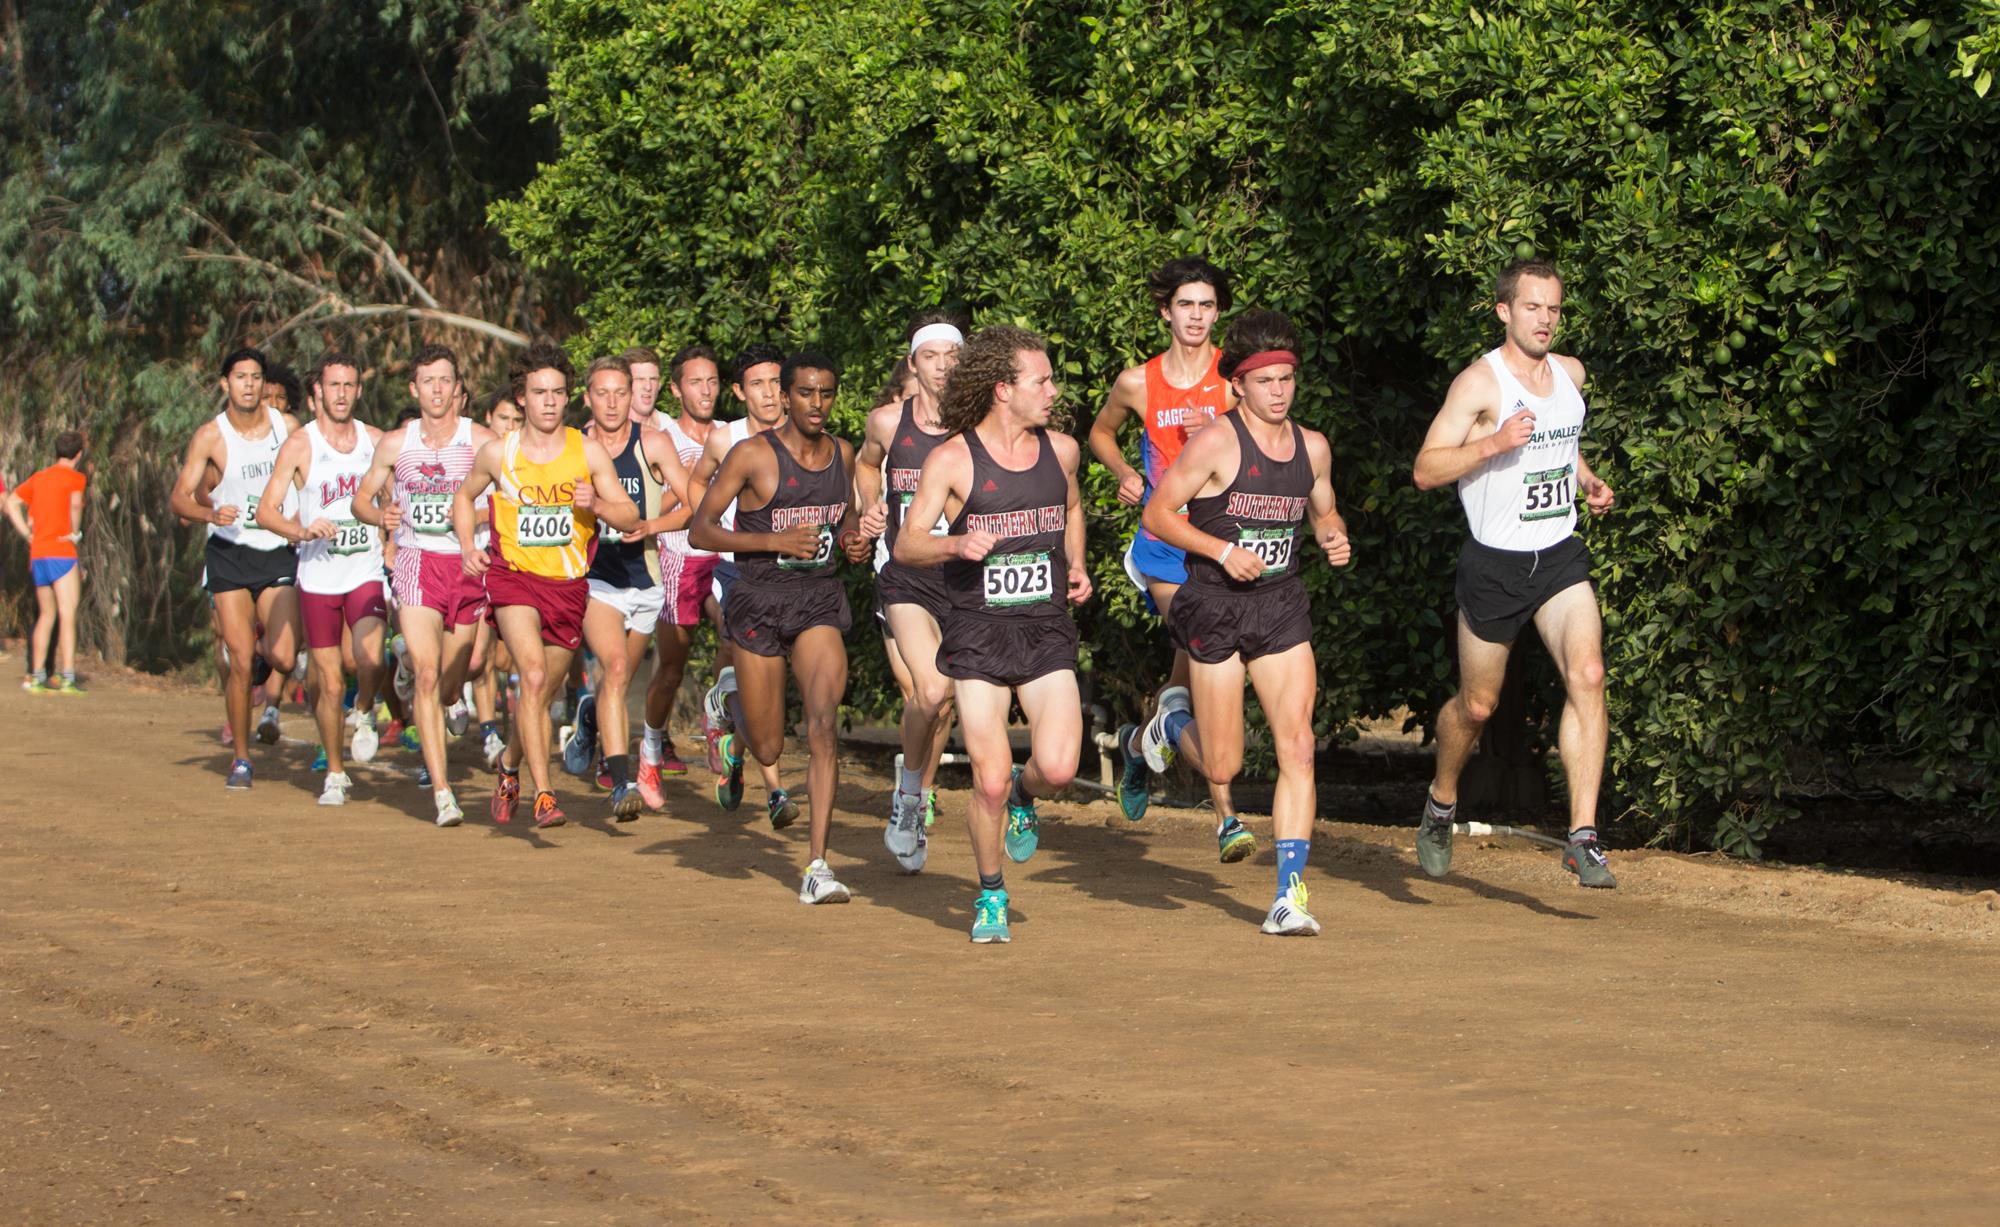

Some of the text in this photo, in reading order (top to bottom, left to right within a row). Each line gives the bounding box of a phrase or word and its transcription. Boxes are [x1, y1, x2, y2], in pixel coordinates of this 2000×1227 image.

[1548, 424, 1582, 441] VALLEY
[320, 472, 363, 510] LM
[518, 481, 575, 506] CMS
[1526, 477, 1570, 511] 5311
[772, 505, 829, 533] SOUTHERN
[1225, 491, 1292, 522] SOUTHERN
[520, 516, 571, 538] 4606
[967, 509, 1038, 538] SOUTHERN
[987, 564, 1048, 595] 5023
